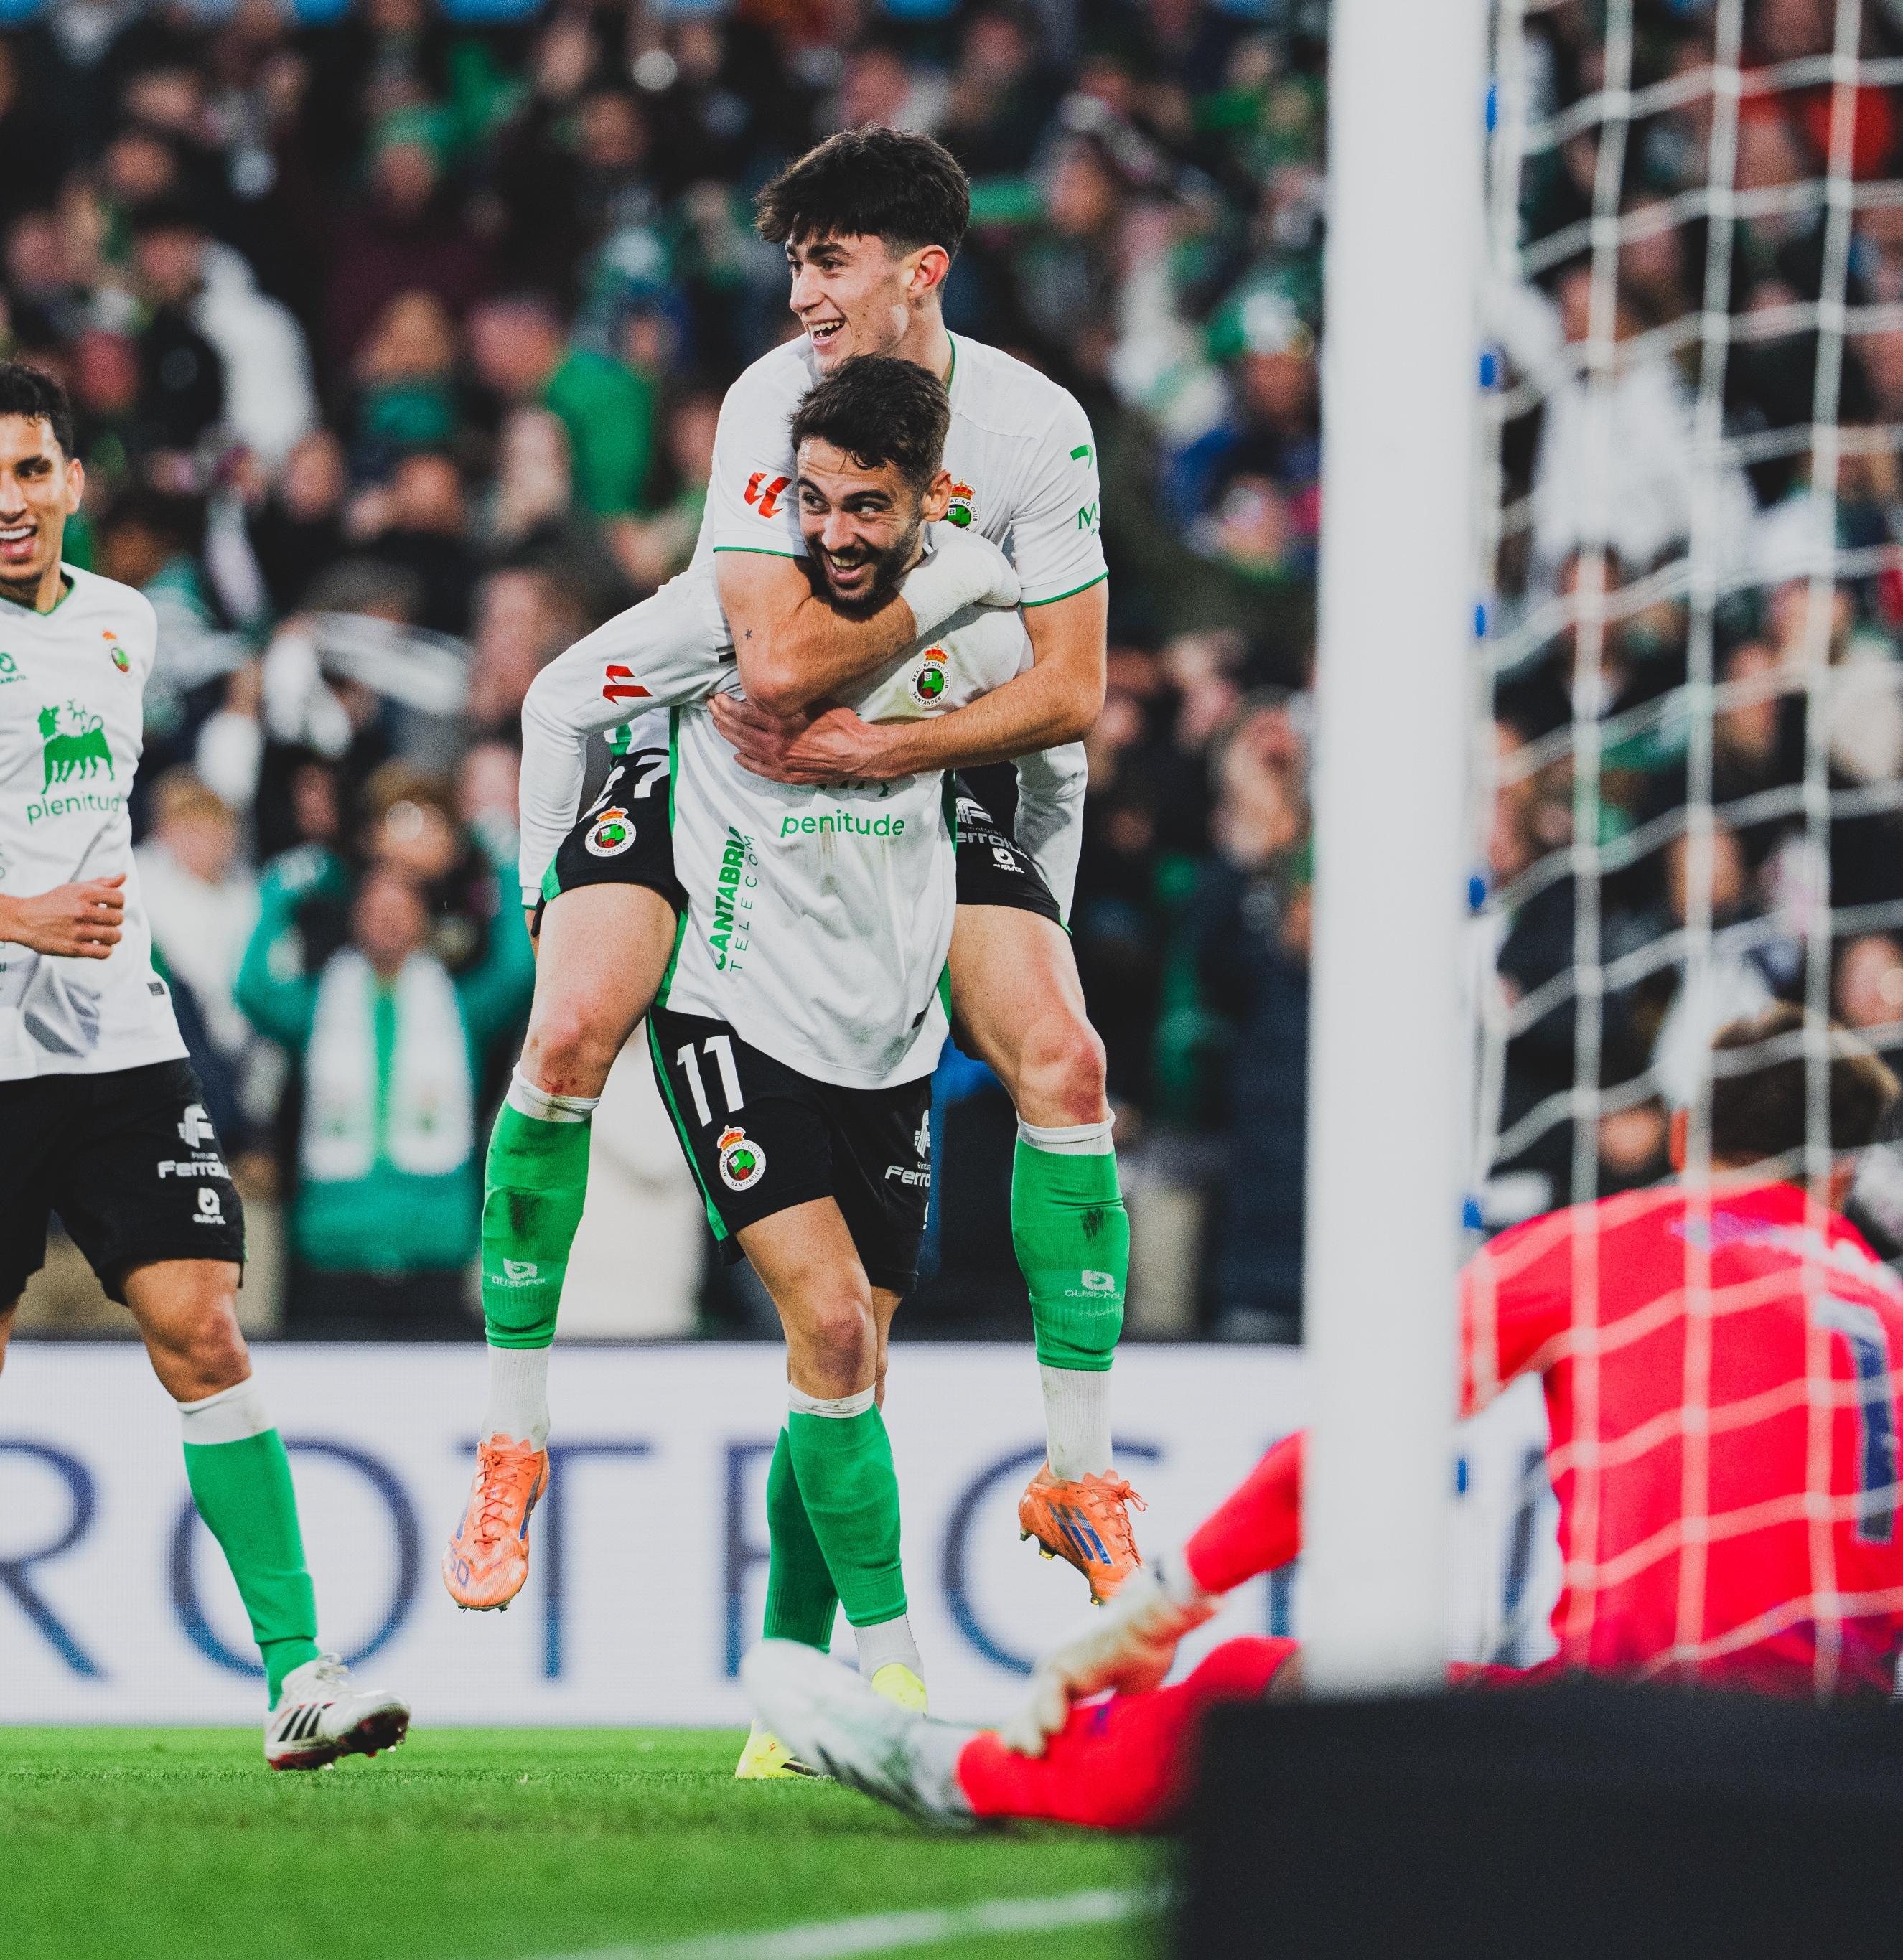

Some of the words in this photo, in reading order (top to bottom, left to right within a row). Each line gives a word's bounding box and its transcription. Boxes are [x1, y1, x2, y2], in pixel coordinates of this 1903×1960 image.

[912, 667, 922, 683] REAL
[923, 661, 945, 671] RACING
[912, 691, 942, 705] SANTANDER
[26, 791, 126, 825] plenitud
[592, 841, 627, 853] SANTANDER
[730, 835, 759, 972] TELECOM
[677, 1035, 744, 1127] 11
[731, 1167, 761, 1187] SANTANDER
